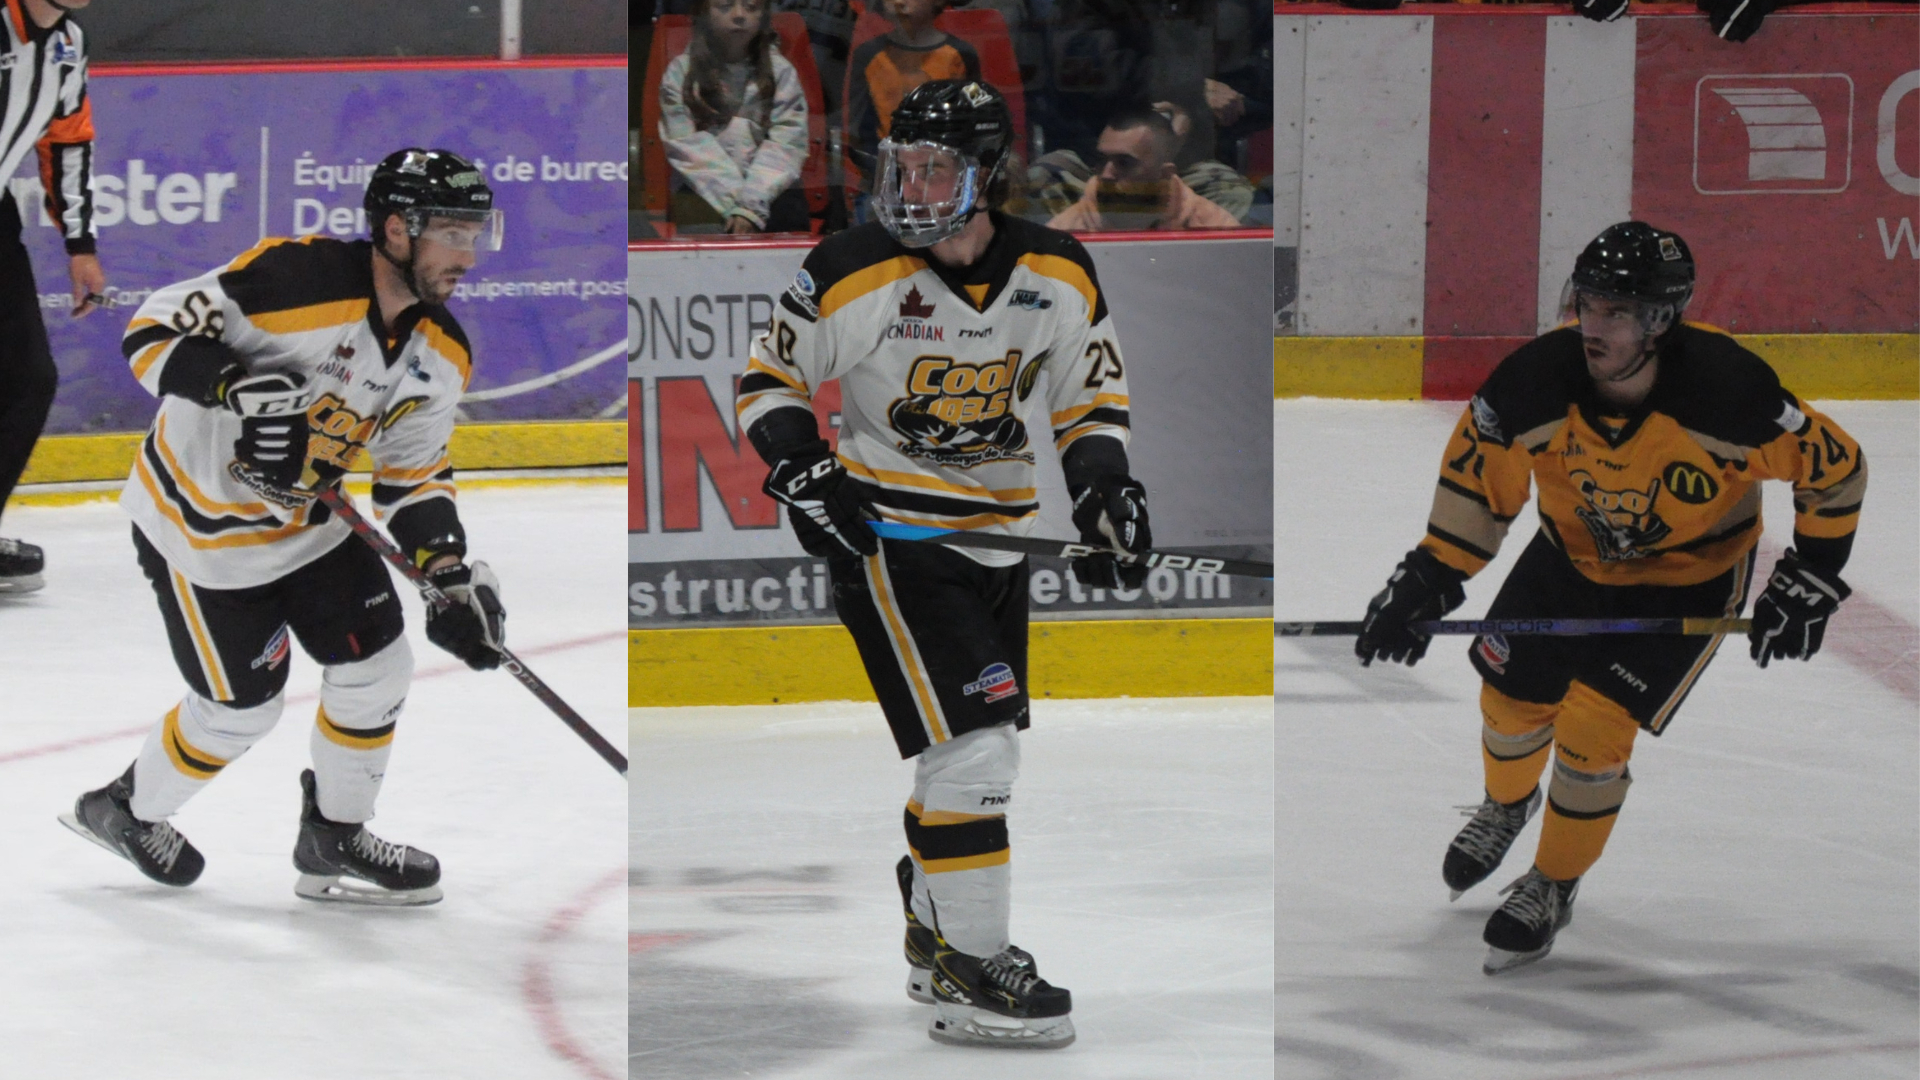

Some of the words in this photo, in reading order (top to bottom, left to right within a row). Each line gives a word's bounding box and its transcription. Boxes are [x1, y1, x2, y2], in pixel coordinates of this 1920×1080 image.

[492, 155, 536, 182] de
[452, 277, 578, 301] quipement
[958, 327, 993, 338] MNM
[909, 352, 1019, 396] Cool
[1609, 662, 1649, 693] MNM
